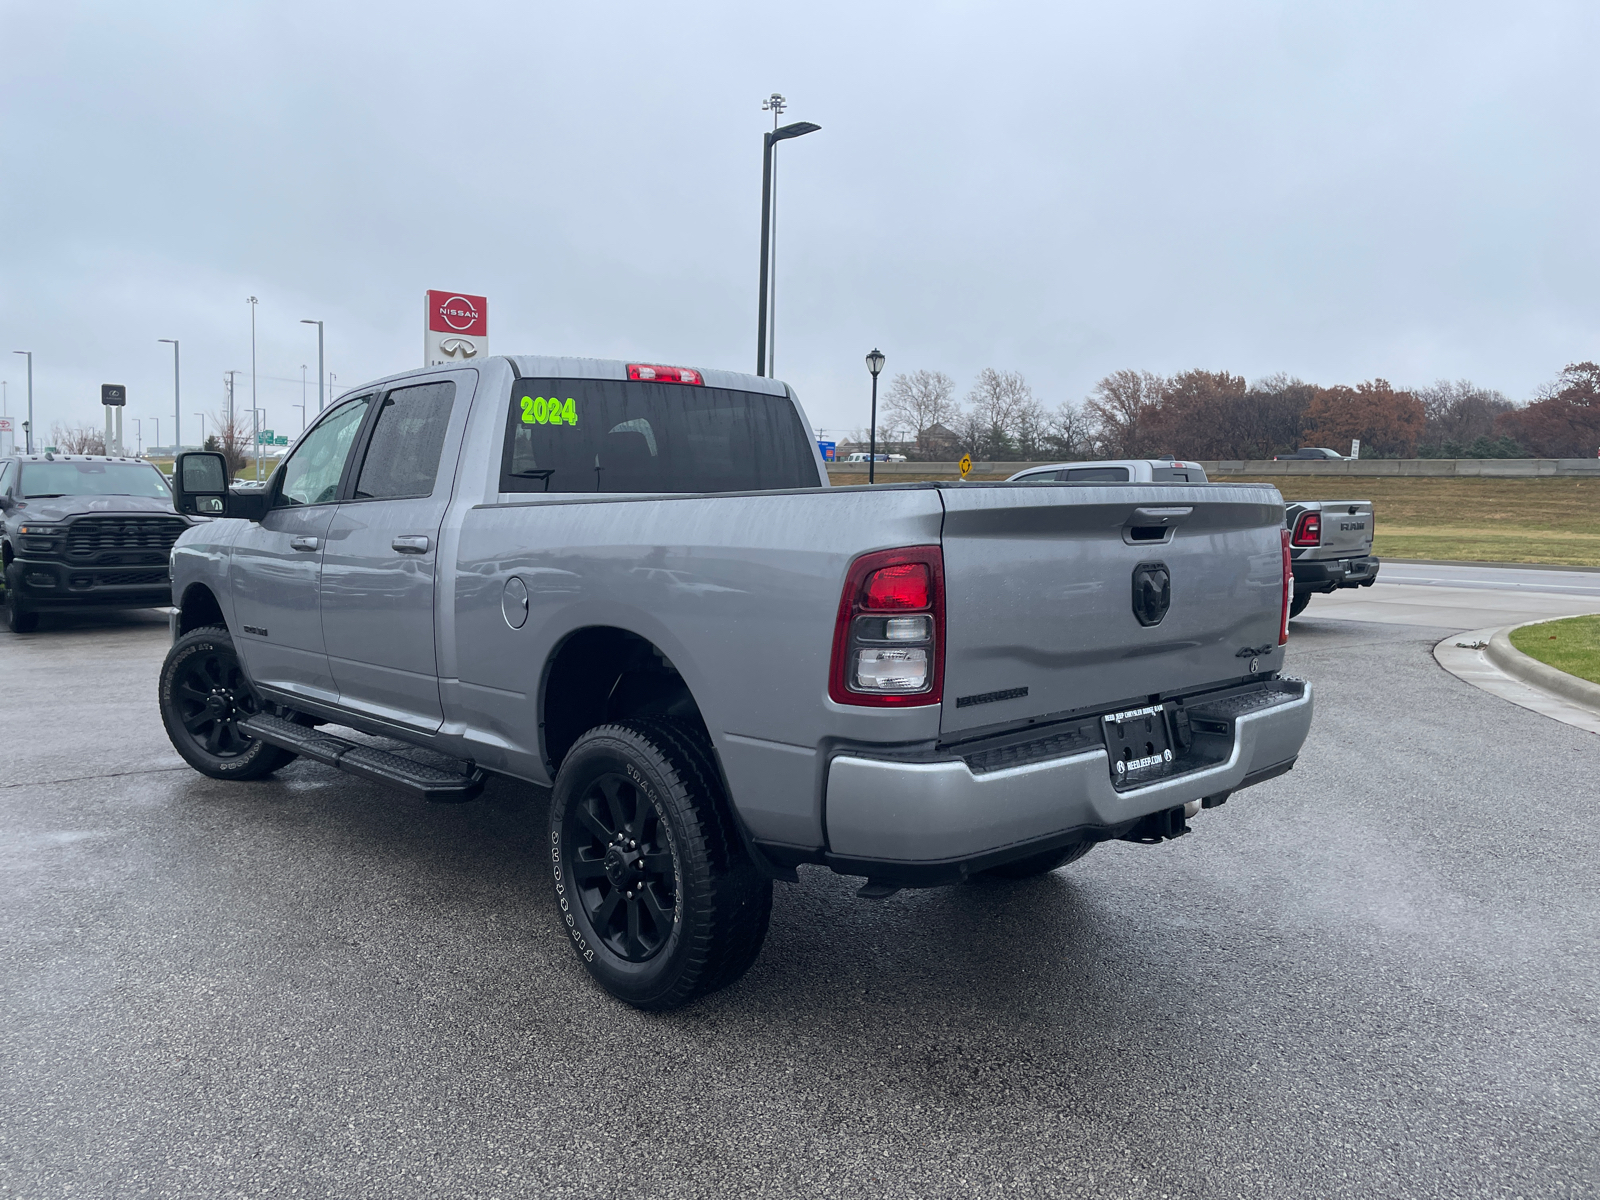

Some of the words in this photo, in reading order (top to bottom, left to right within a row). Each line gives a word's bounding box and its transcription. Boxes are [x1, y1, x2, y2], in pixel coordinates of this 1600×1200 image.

[440, 308, 478, 318] NISSAN
[520, 396, 578, 426] 2024
[1340, 522, 1365, 531] RAM
[626, 763, 682, 882] TRANSFORCE
